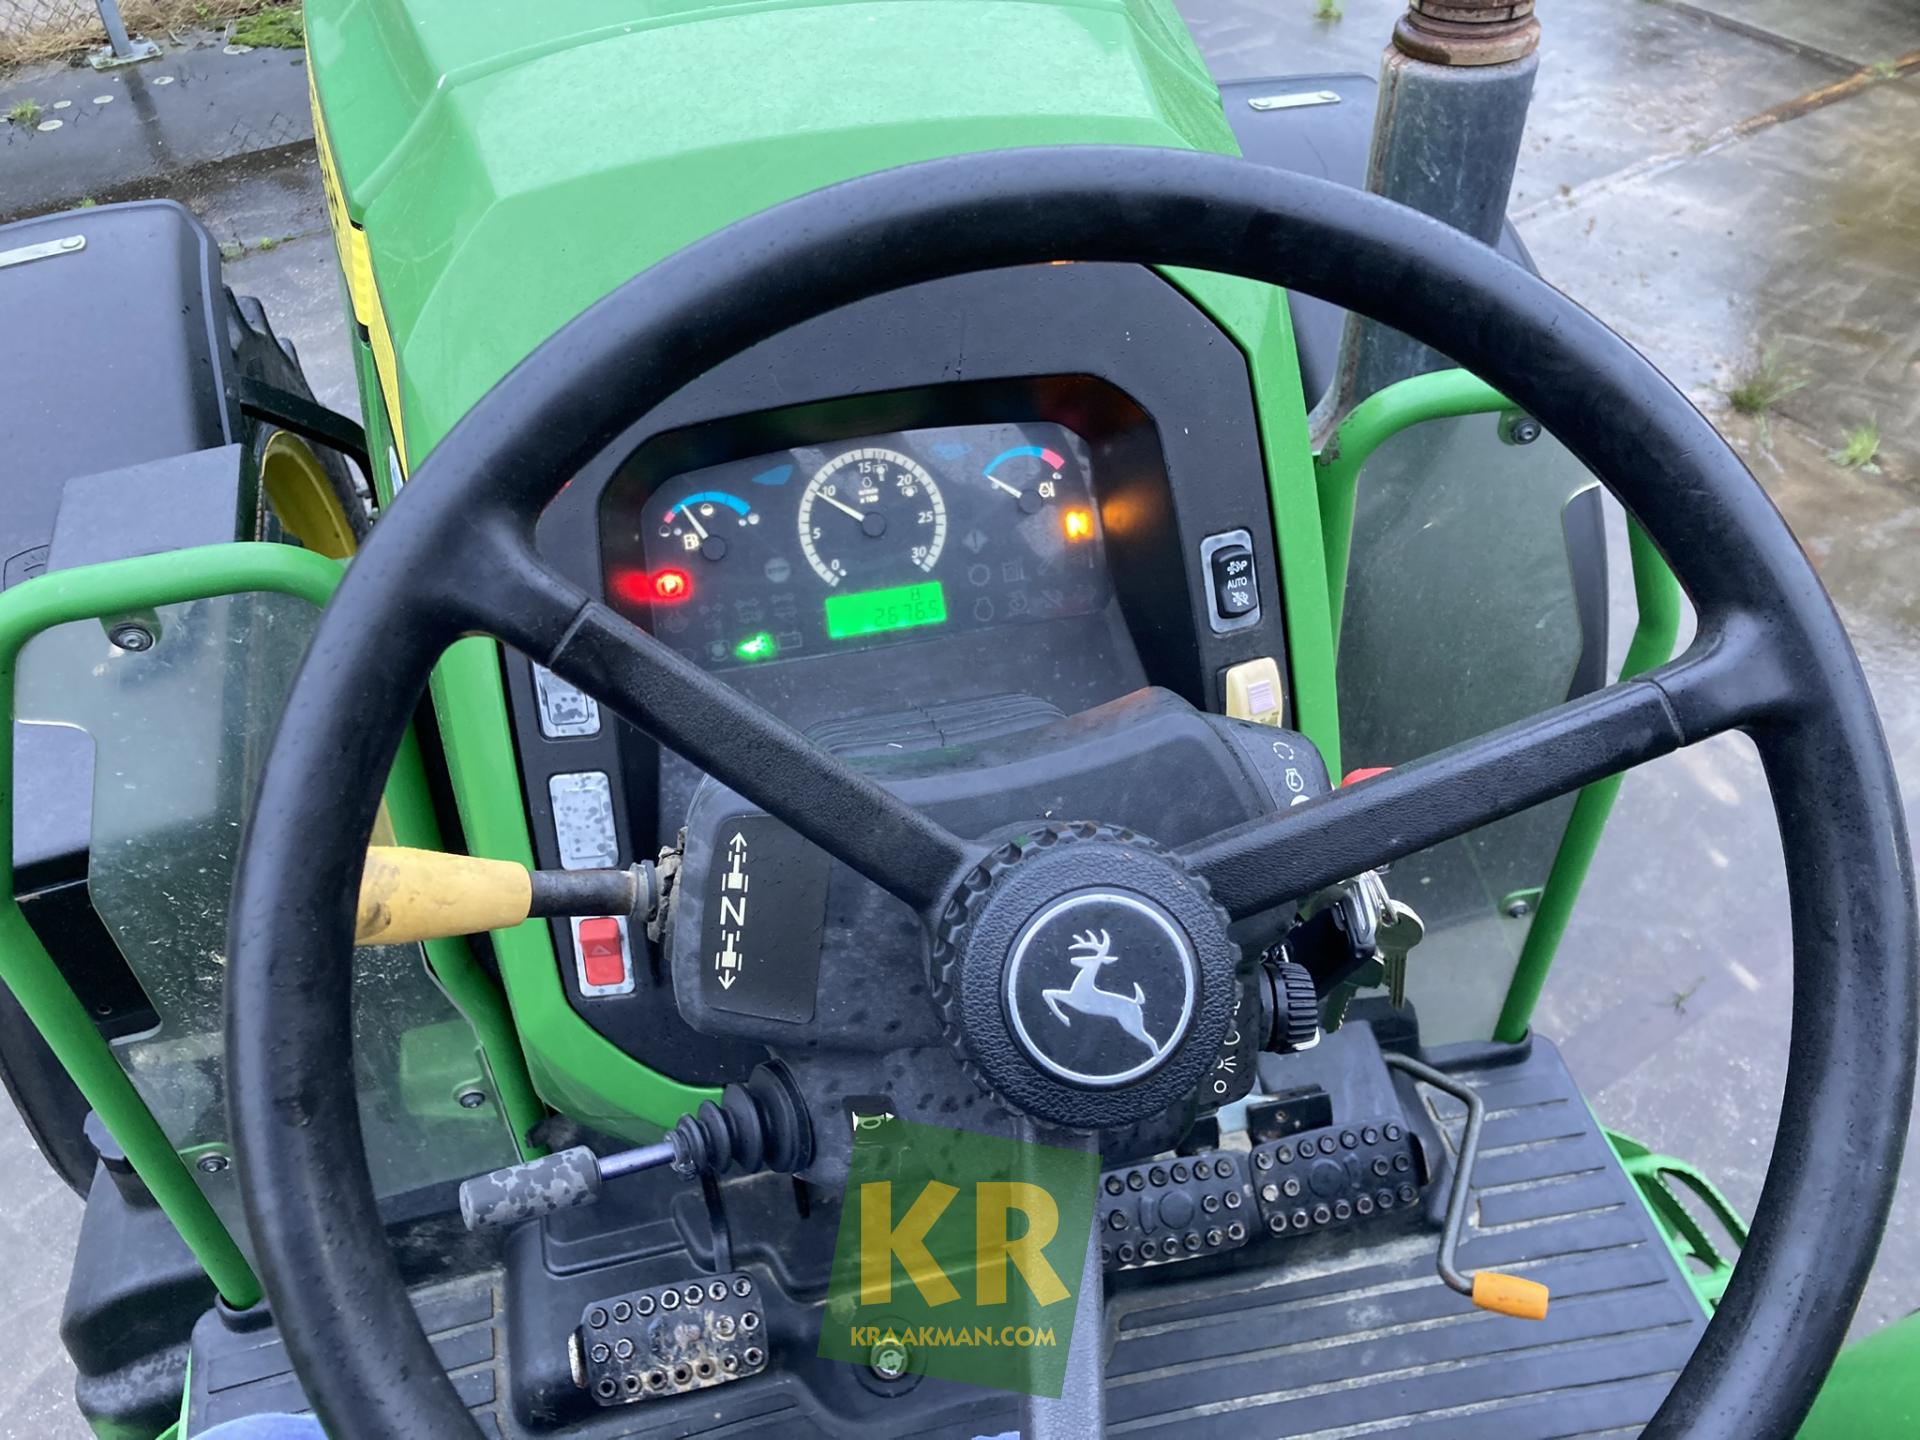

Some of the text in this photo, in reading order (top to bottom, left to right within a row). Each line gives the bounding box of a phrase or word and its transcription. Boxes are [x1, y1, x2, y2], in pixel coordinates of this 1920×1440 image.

[858, 461, 872, 473] 15
[896, 473, 913, 487] 20
[822, 484, 836, 497] 10
[917, 510, 934, 524] 25
[812, 527, 821, 540] 5
[910, 545, 927, 559] 30
[830, 558, 840, 571] 0
[1227, 576, 1247, 590] AUTO
[719, 896, 746, 927] N
